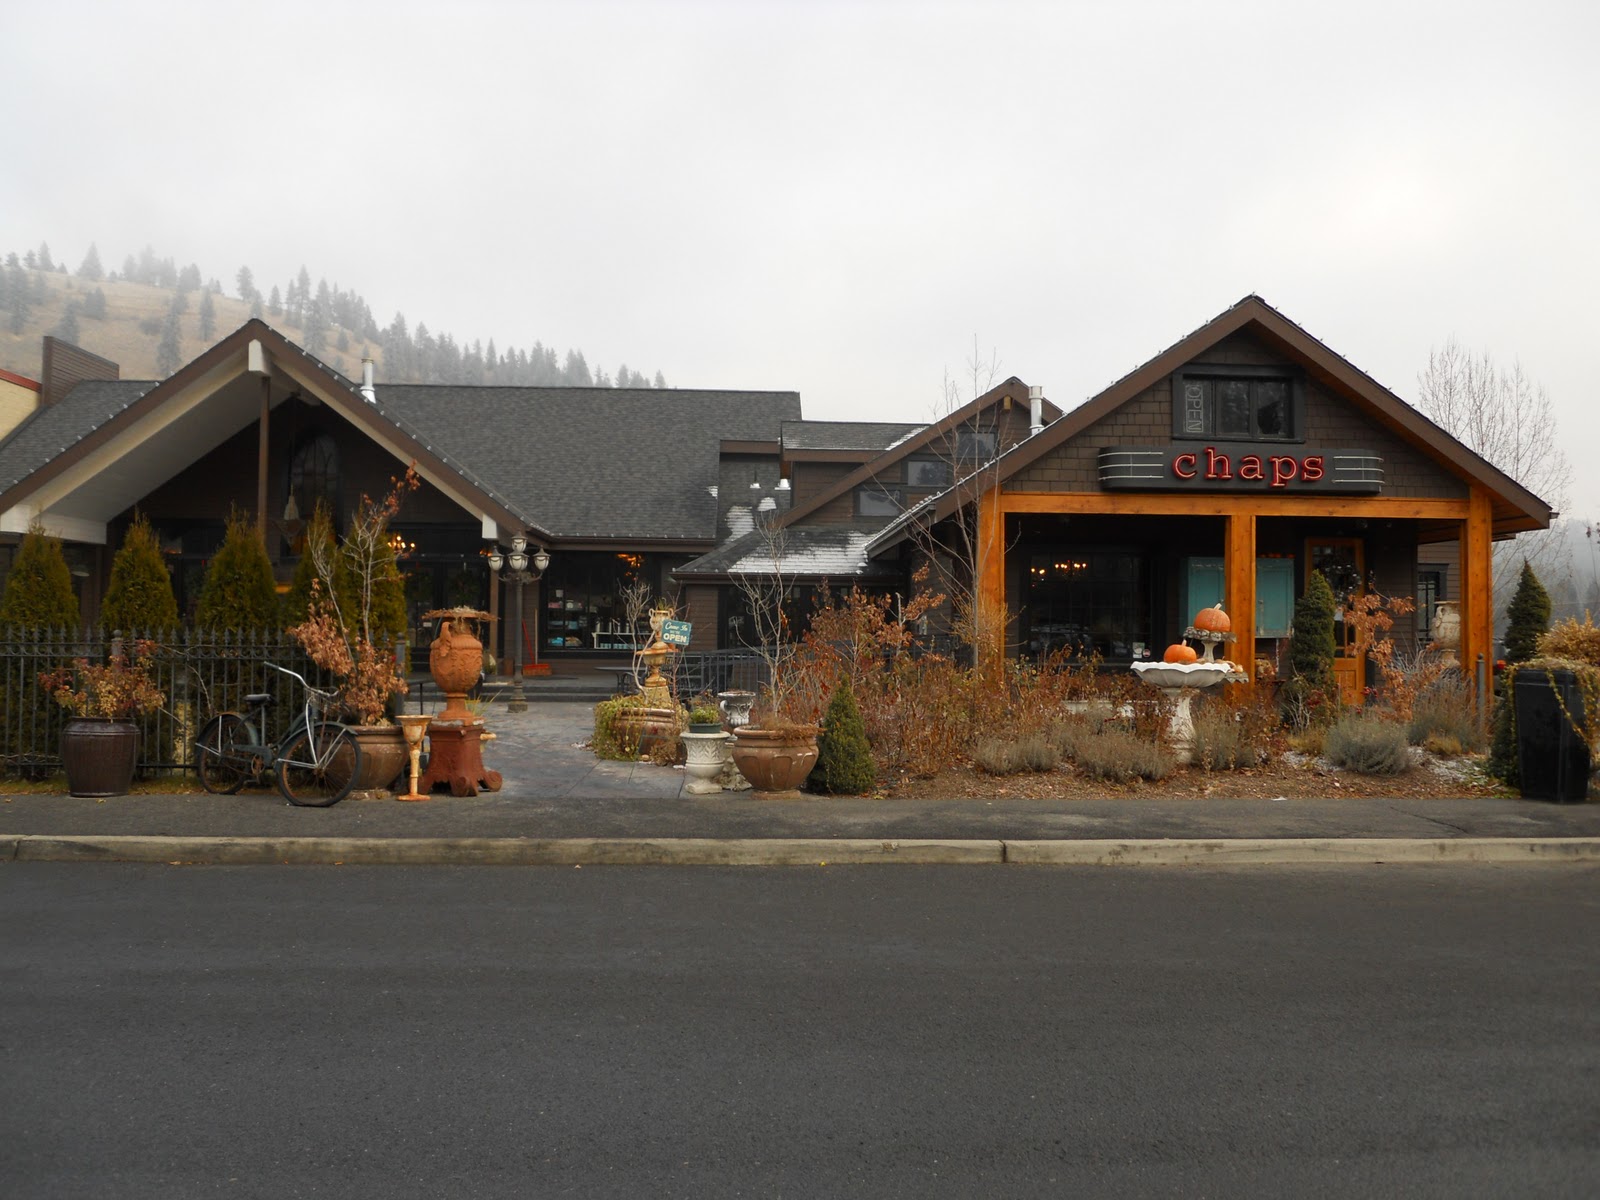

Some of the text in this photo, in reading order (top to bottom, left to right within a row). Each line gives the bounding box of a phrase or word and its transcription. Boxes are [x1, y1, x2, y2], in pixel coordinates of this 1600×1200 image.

[1187, 386, 1202, 430] OPEN
[1173, 447, 1324, 488] chaps
[663, 633, 687, 643] OPEN
